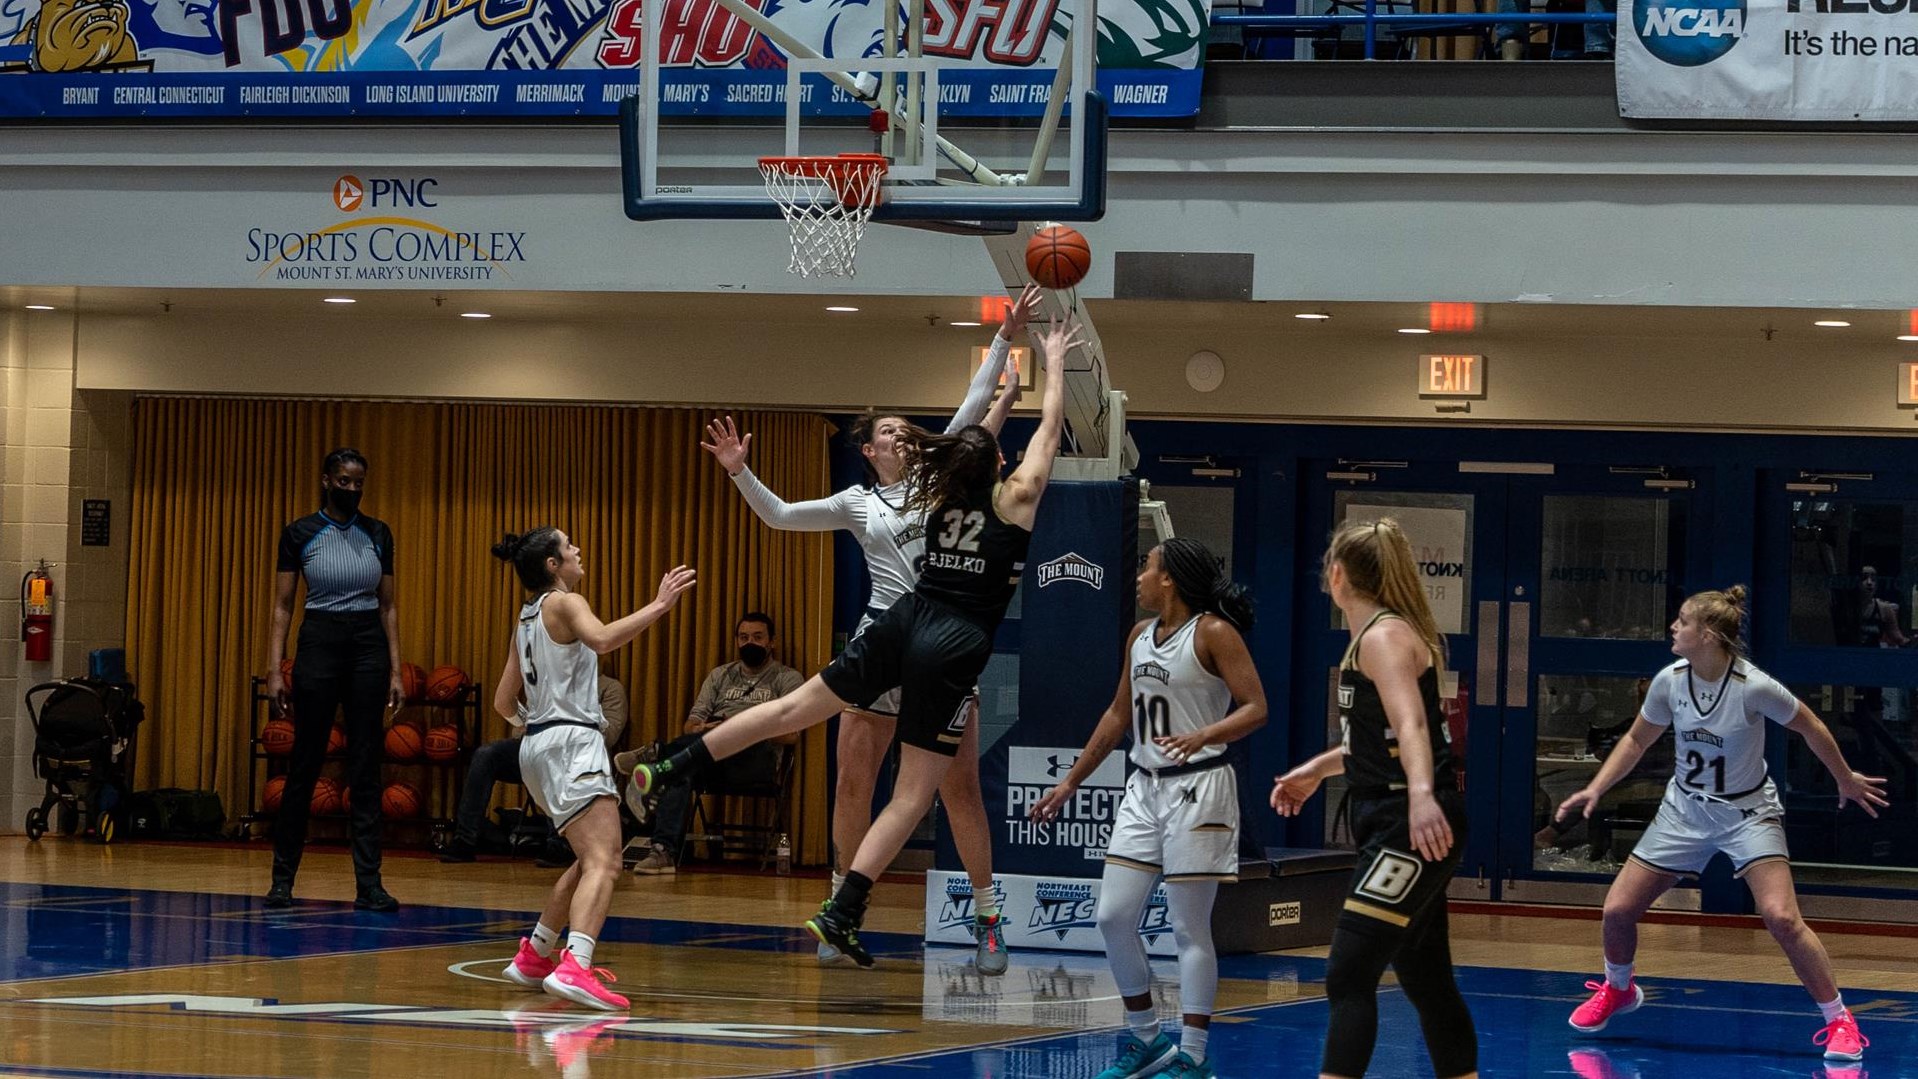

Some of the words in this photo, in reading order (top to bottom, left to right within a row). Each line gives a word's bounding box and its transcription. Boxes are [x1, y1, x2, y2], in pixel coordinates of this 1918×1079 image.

[1642, 8, 1742, 37] NCAA
[1832, 30, 1877, 55] the
[63, 87, 99, 104] BRYANT
[113, 87, 156, 104] CENTRAL
[159, 86, 225, 104] CONNECTICUT
[240, 86, 290, 104] FAIRLEIGH
[292, 86, 350, 103] DICKINSON
[366, 85, 393, 103] LONG
[396, 85, 434, 103] ISLAND
[437, 84, 499, 103] UNIVERSITY
[516, 84, 585, 102] MERRIMACK
[664, 84, 710, 102] MARY'S
[727, 84, 771, 102] SACRED
[990, 85, 1026, 103] SAINT
[1113, 85, 1168, 103] WAGNER
[369, 179, 438, 208] PNC
[277, 266, 331, 280] MOUNT
[335, 266, 352, 280] ST.
[356, 266, 404, 280] MARY'S
[408, 266, 493, 280] UNIVERSITY
[1430, 357, 1473, 391] EXIT
[938, 509, 986, 551] 32
[1041, 563, 1063, 579] THE
[1064, 562, 1101, 584] MOUNT
[1145, 664, 1170, 685] MOUNT
[1135, 692, 1171, 745] 10
[1696, 732, 1724, 748] MOUNT
[1684, 750, 1726, 793] 21
[1006, 820, 1050, 845] THIS
[1056, 822, 1112, 847] HOUS
[1357, 851, 1420, 902] B
[1037, 883, 1091, 891] NORTHEAST
[1037, 890, 1091, 898] CONFERENCE
[1028, 898, 1096, 928] NEC
